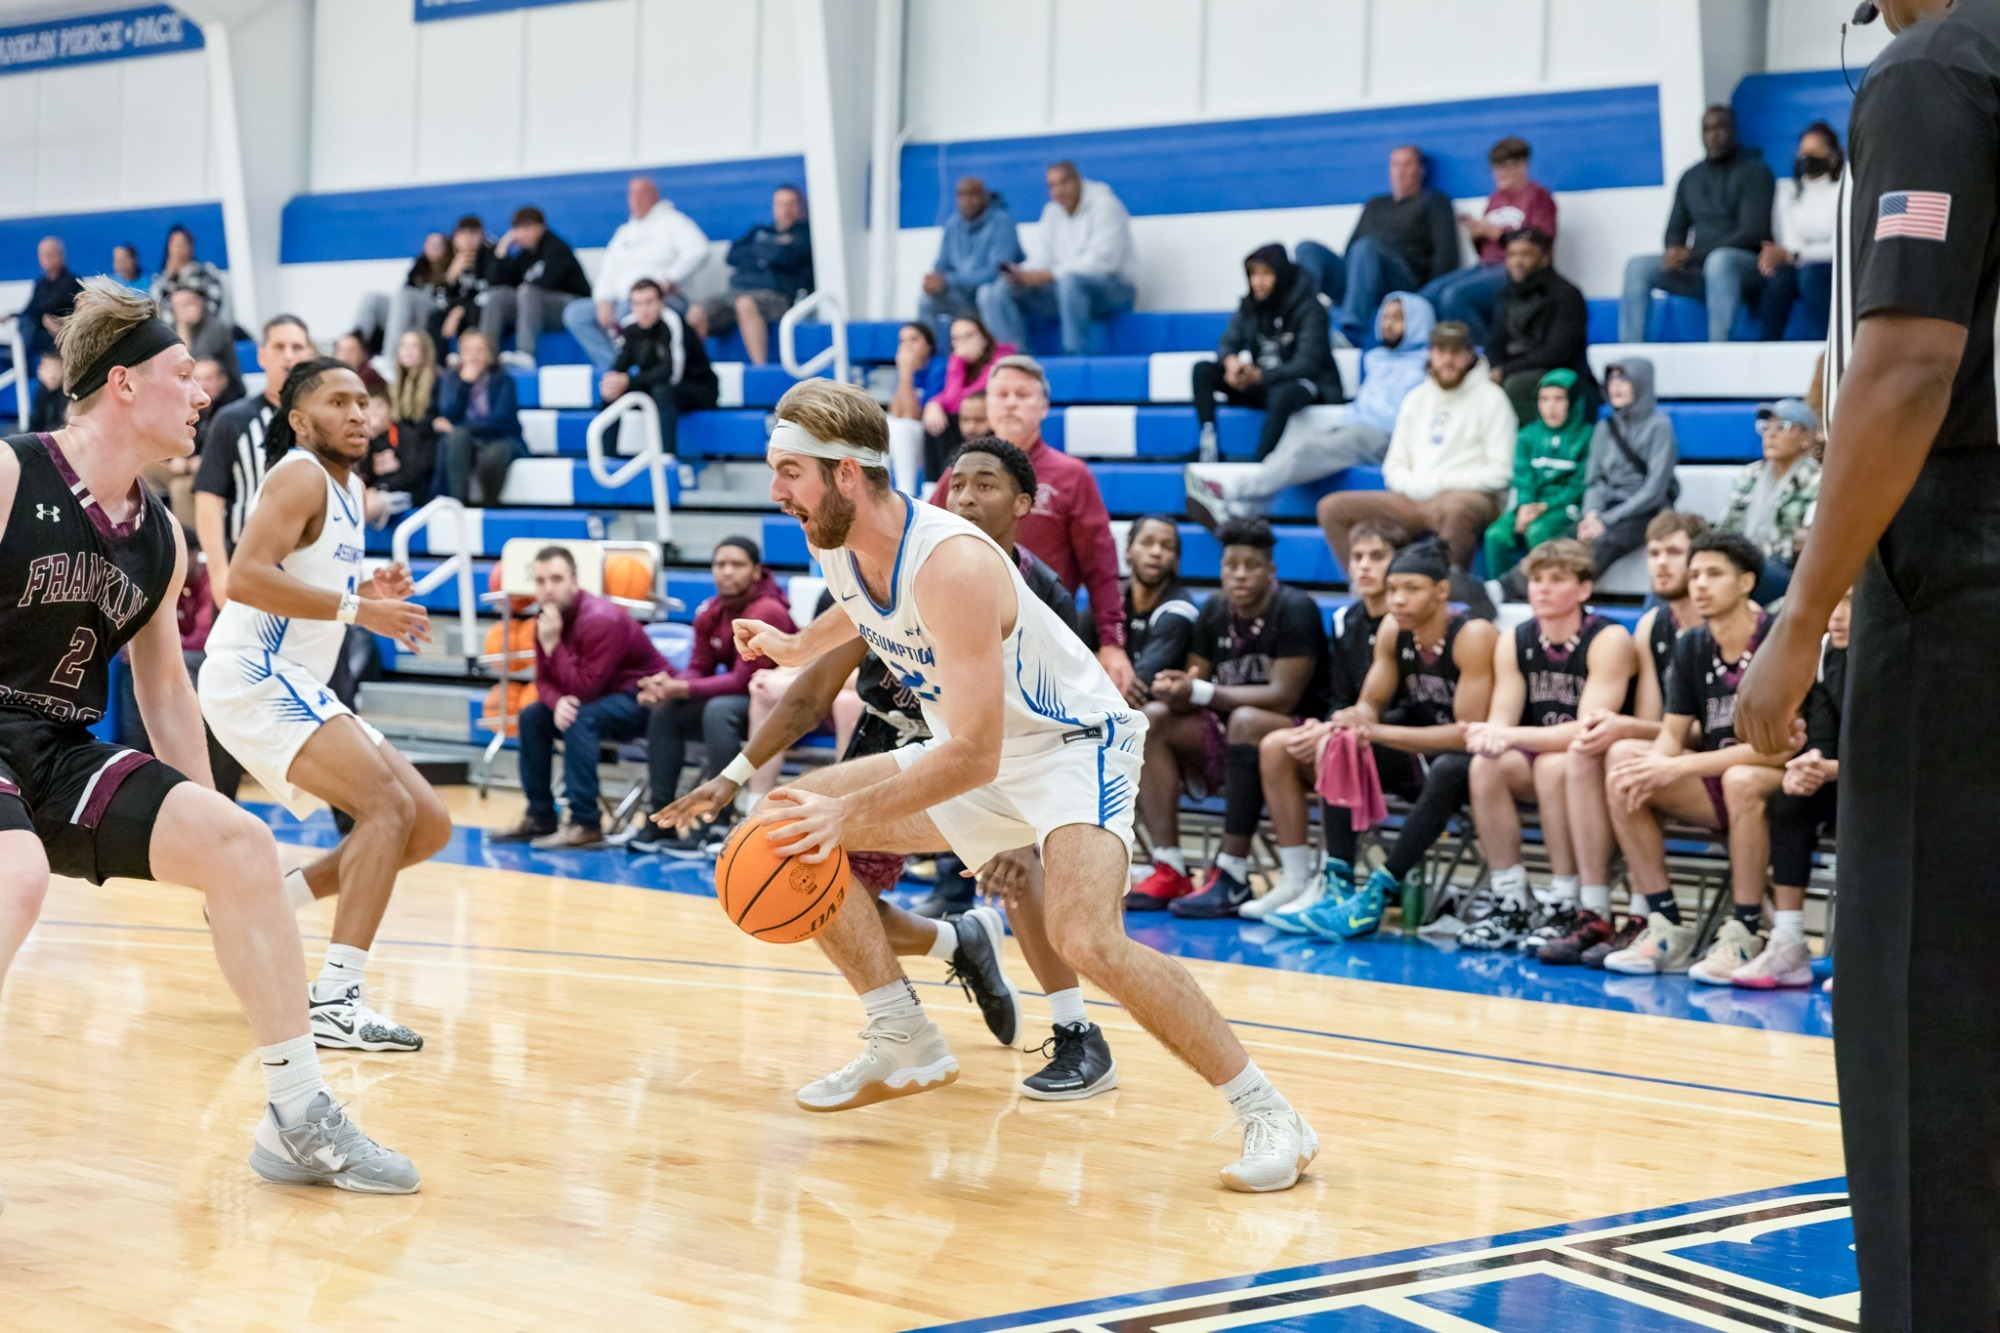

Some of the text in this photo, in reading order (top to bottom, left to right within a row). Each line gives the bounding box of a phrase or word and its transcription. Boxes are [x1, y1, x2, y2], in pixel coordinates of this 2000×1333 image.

[59, 20, 124, 57] PIERCE
[133, 13, 183, 47] PACE
[17, 551, 149, 631] FRANKLIN
[50, 626, 97, 689] 2
